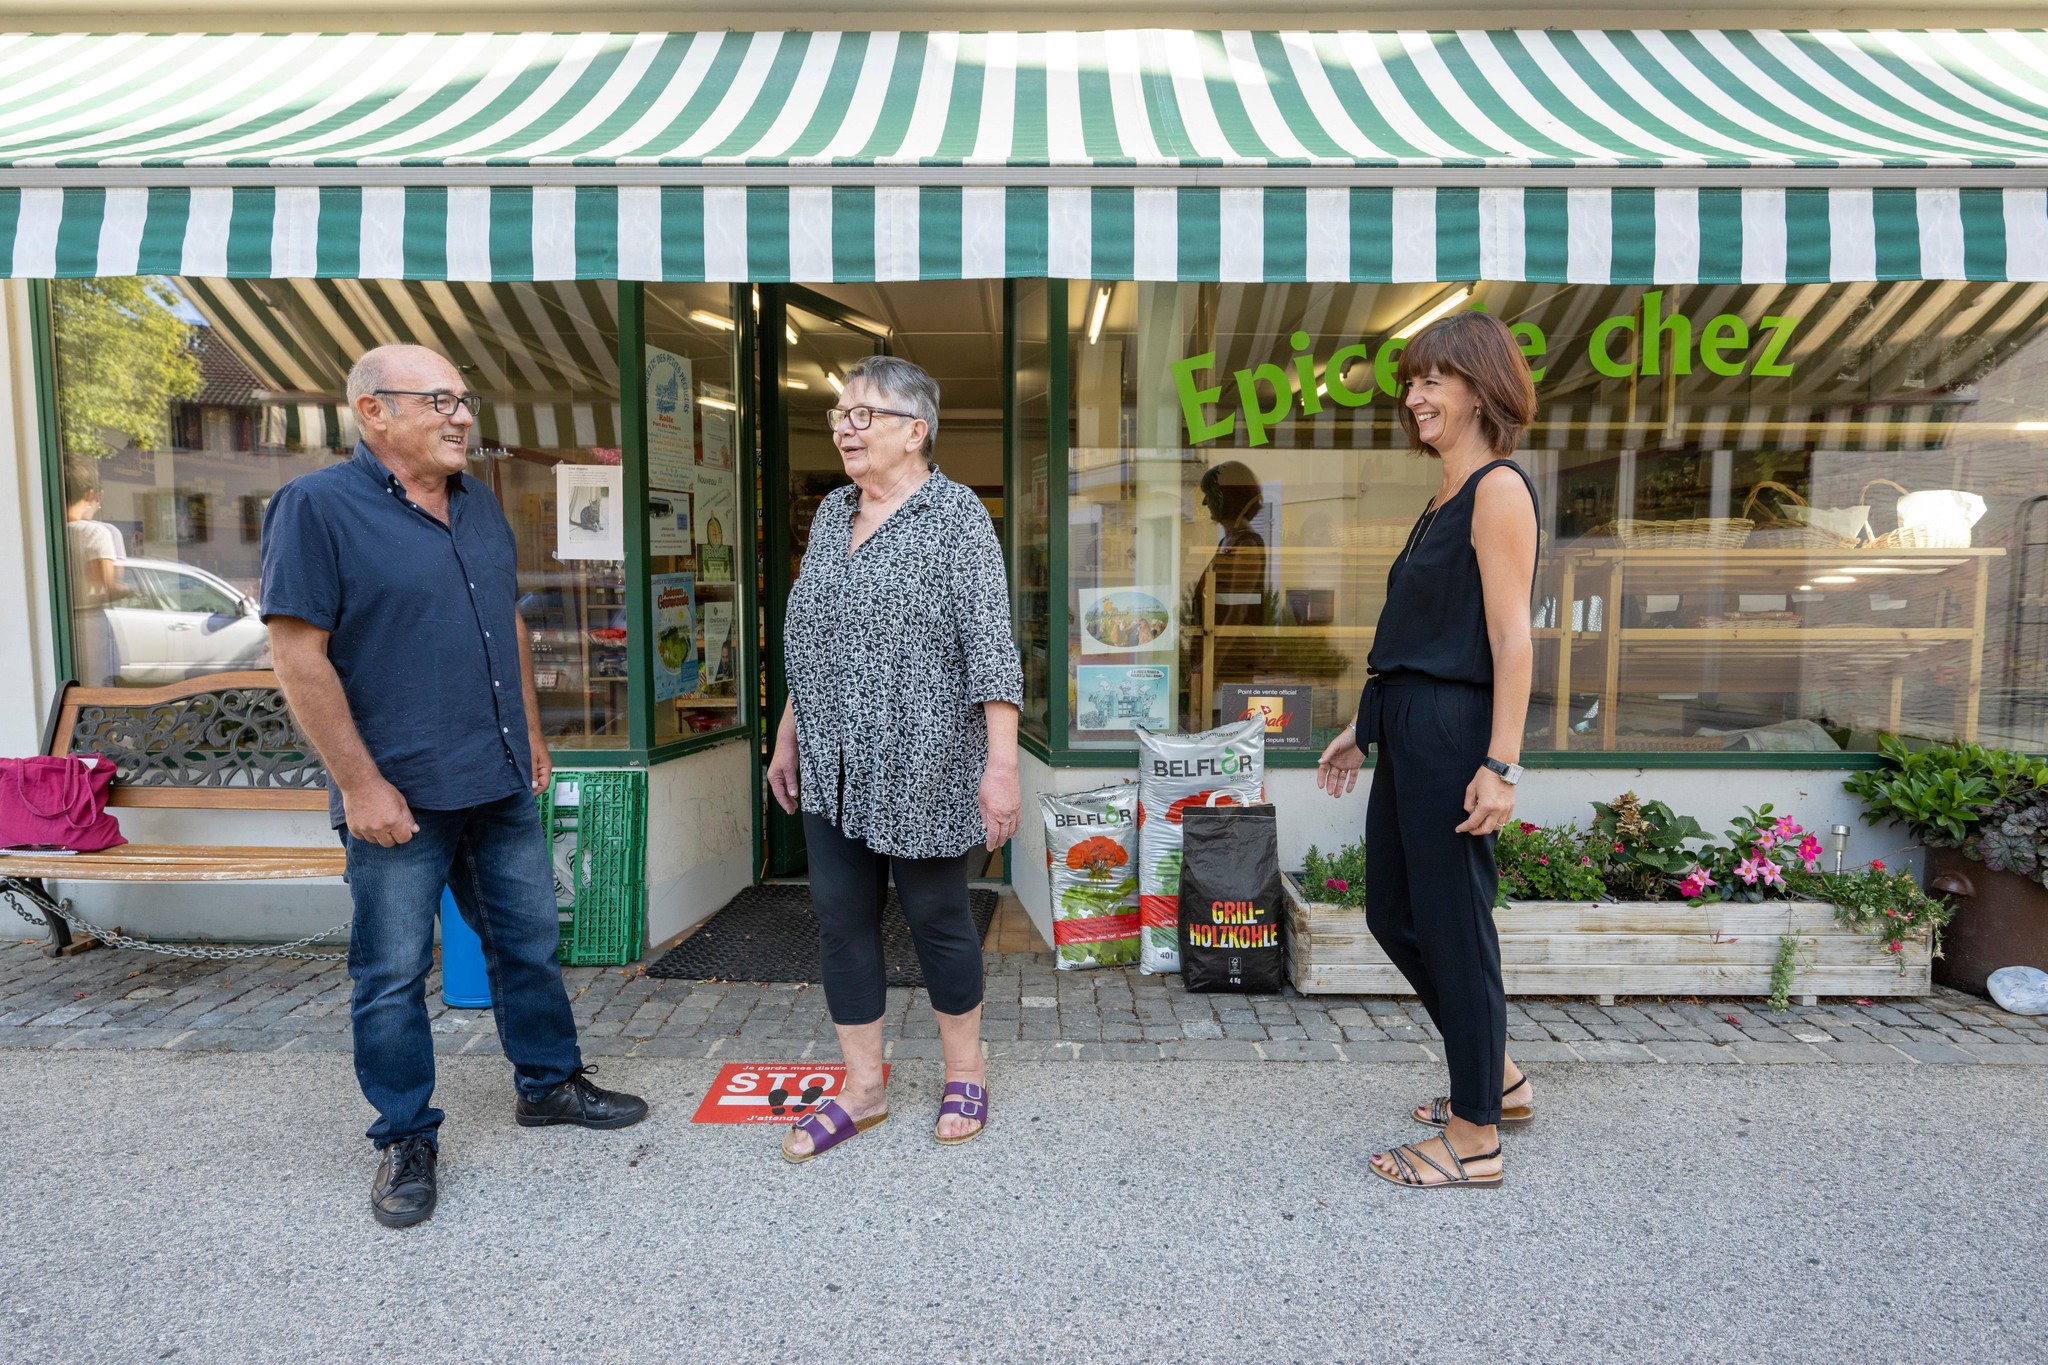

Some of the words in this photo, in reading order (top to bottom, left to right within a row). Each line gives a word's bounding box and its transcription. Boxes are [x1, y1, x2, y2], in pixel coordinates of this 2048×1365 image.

[1169, 302, 1547, 447] Epicee
[1589, 290, 1801, 377] chez
[658, 414, 674, 423] Rolle
[1154, 747, 1253, 777] BELFLOR
[1230, 773, 1254, 782] suisse
[1055, 805, 1132, 828] BELFLOR
[1212, 901, 1265, 925] GRILL-
[1189, 923, 1278, 949] HOLZKOHLE
[726, 1072, 847, 1093] STO
